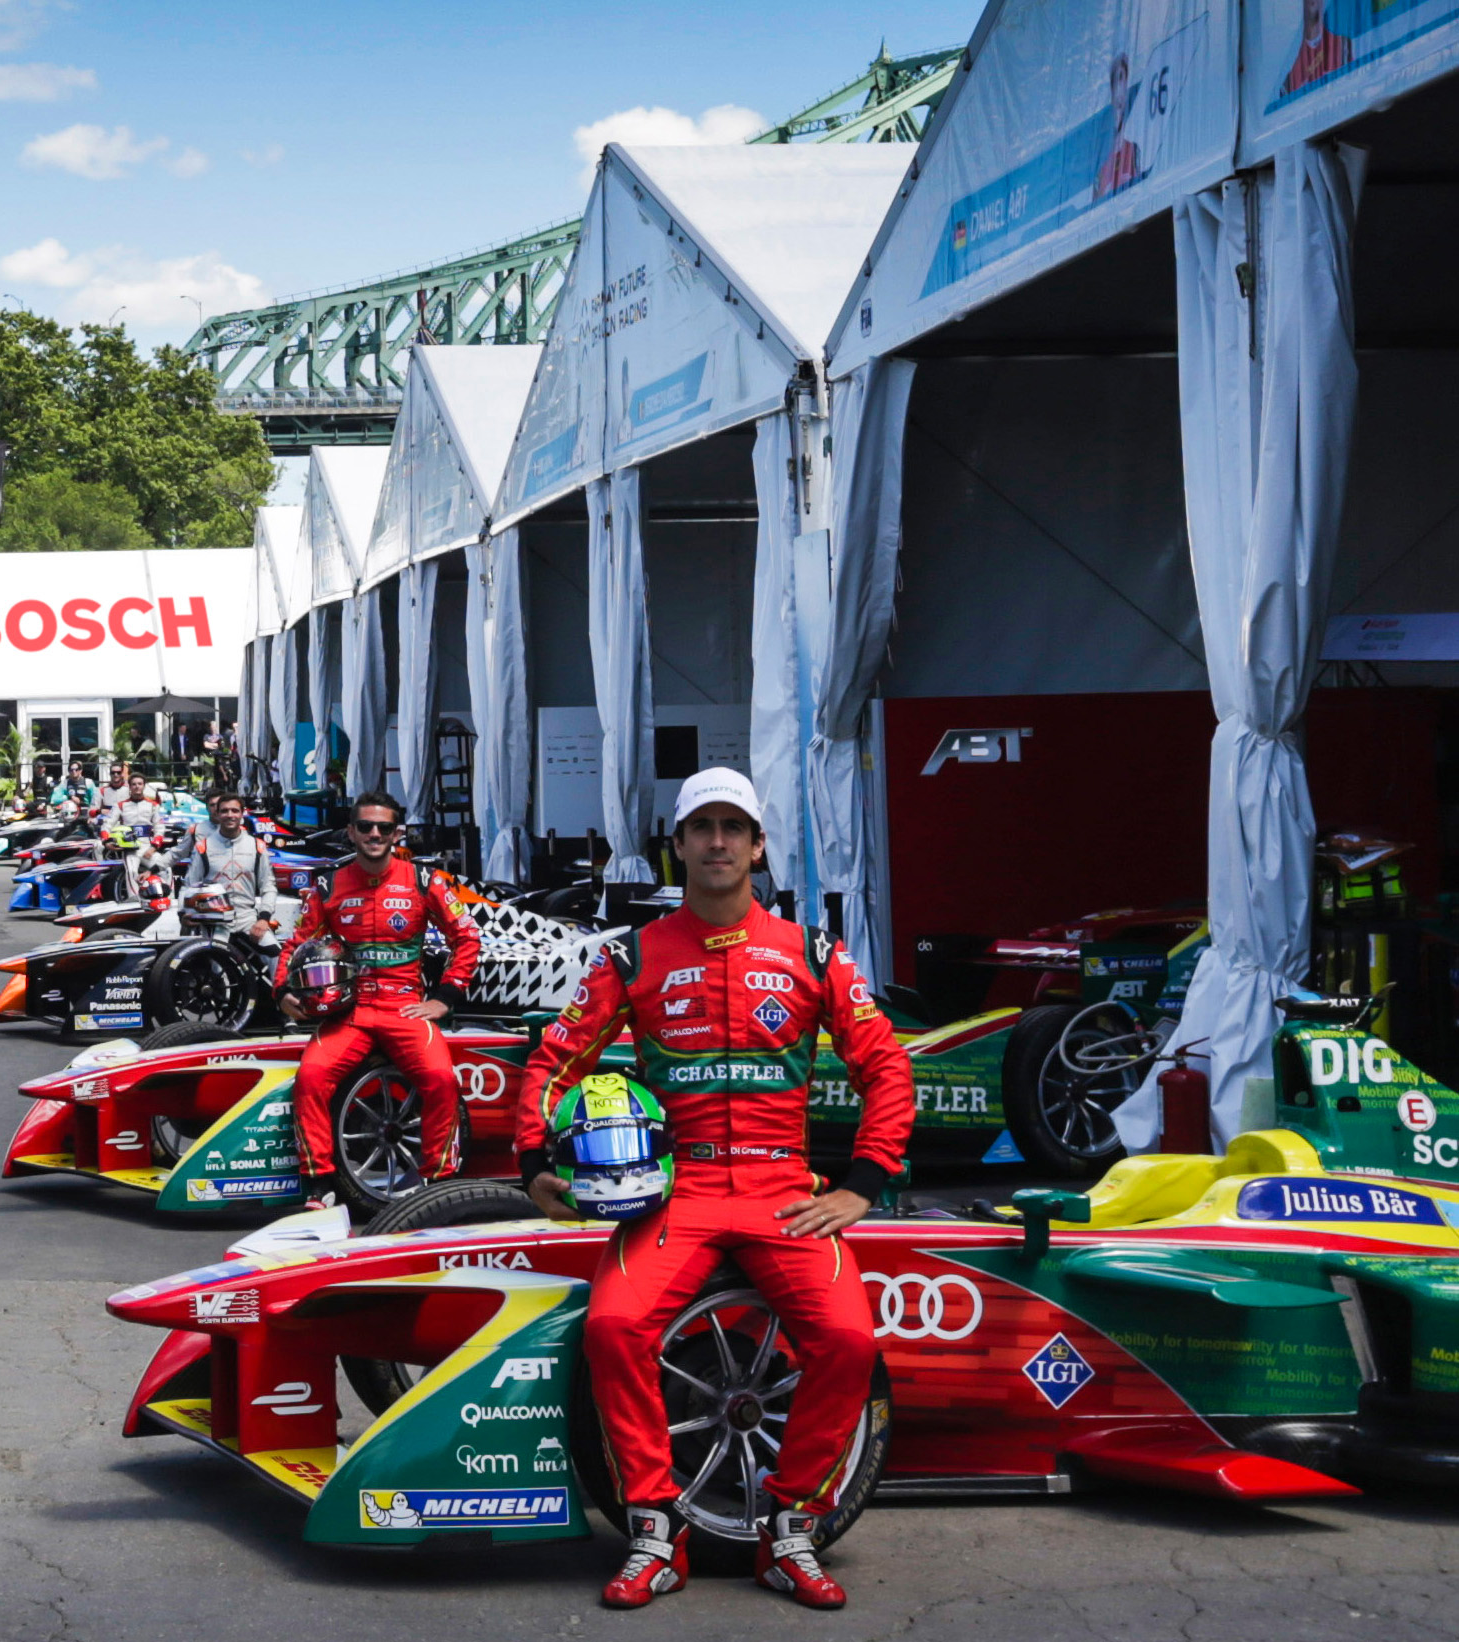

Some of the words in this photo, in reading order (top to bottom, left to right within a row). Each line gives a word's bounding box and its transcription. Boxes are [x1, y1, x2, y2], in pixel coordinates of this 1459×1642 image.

[1149, 66, 1170, 121] 66
[970, 196, 1007, 242] DANIEL
[1007, 184, 1029, 219] ABT
[618, 296, 648, 330] RACING
[920, 727, 1034, 776] ABT
[255, 821, 277, 833] ENG
[711, 931, 747, 947] DHL
[1109, 958, 1164, 970] MCHELIN
[660, 966, 707, 994] ABT
[1106, 979, 1148, 1001] ABT
[105, 987, 143, 1000] VARIETY
[89, 1001, 142, 1012] Panasonic
[664, 998, 691, 1016] WE
[759, 1008, 783, 1022] LGT
[668, 1063, 786, 1082] SCHAEFFLER
[1309, 1037, 1393, 1087] DIG
[73, 1080, 97, 1097] WE
[808, 1080, 989, 1113] CHAFLER
[257, 1101, 294, 1122] ABT
[1406, 1098, 1428, 1125] E
[230, 1158, 267, 1171] SONAX
[222, 1179, 299, 1193] MICHELIN
[1281, 1184, 1364, 1217] Julius
[1368, 1189, 1417, 1217] Bär
[438, 1250, 534, 1270] KUKA
[194, 1292, 237, 1317] WE
[489, 1357, 559, 1389] ABT
[1035, 1359, 1084, 1386] LGT
[1265, 1367, 1324, 1387] Mobility
[460, 1402, 565, 1428] QUALCOMM
[422, 1495, 564, 1517] MICHELIN
